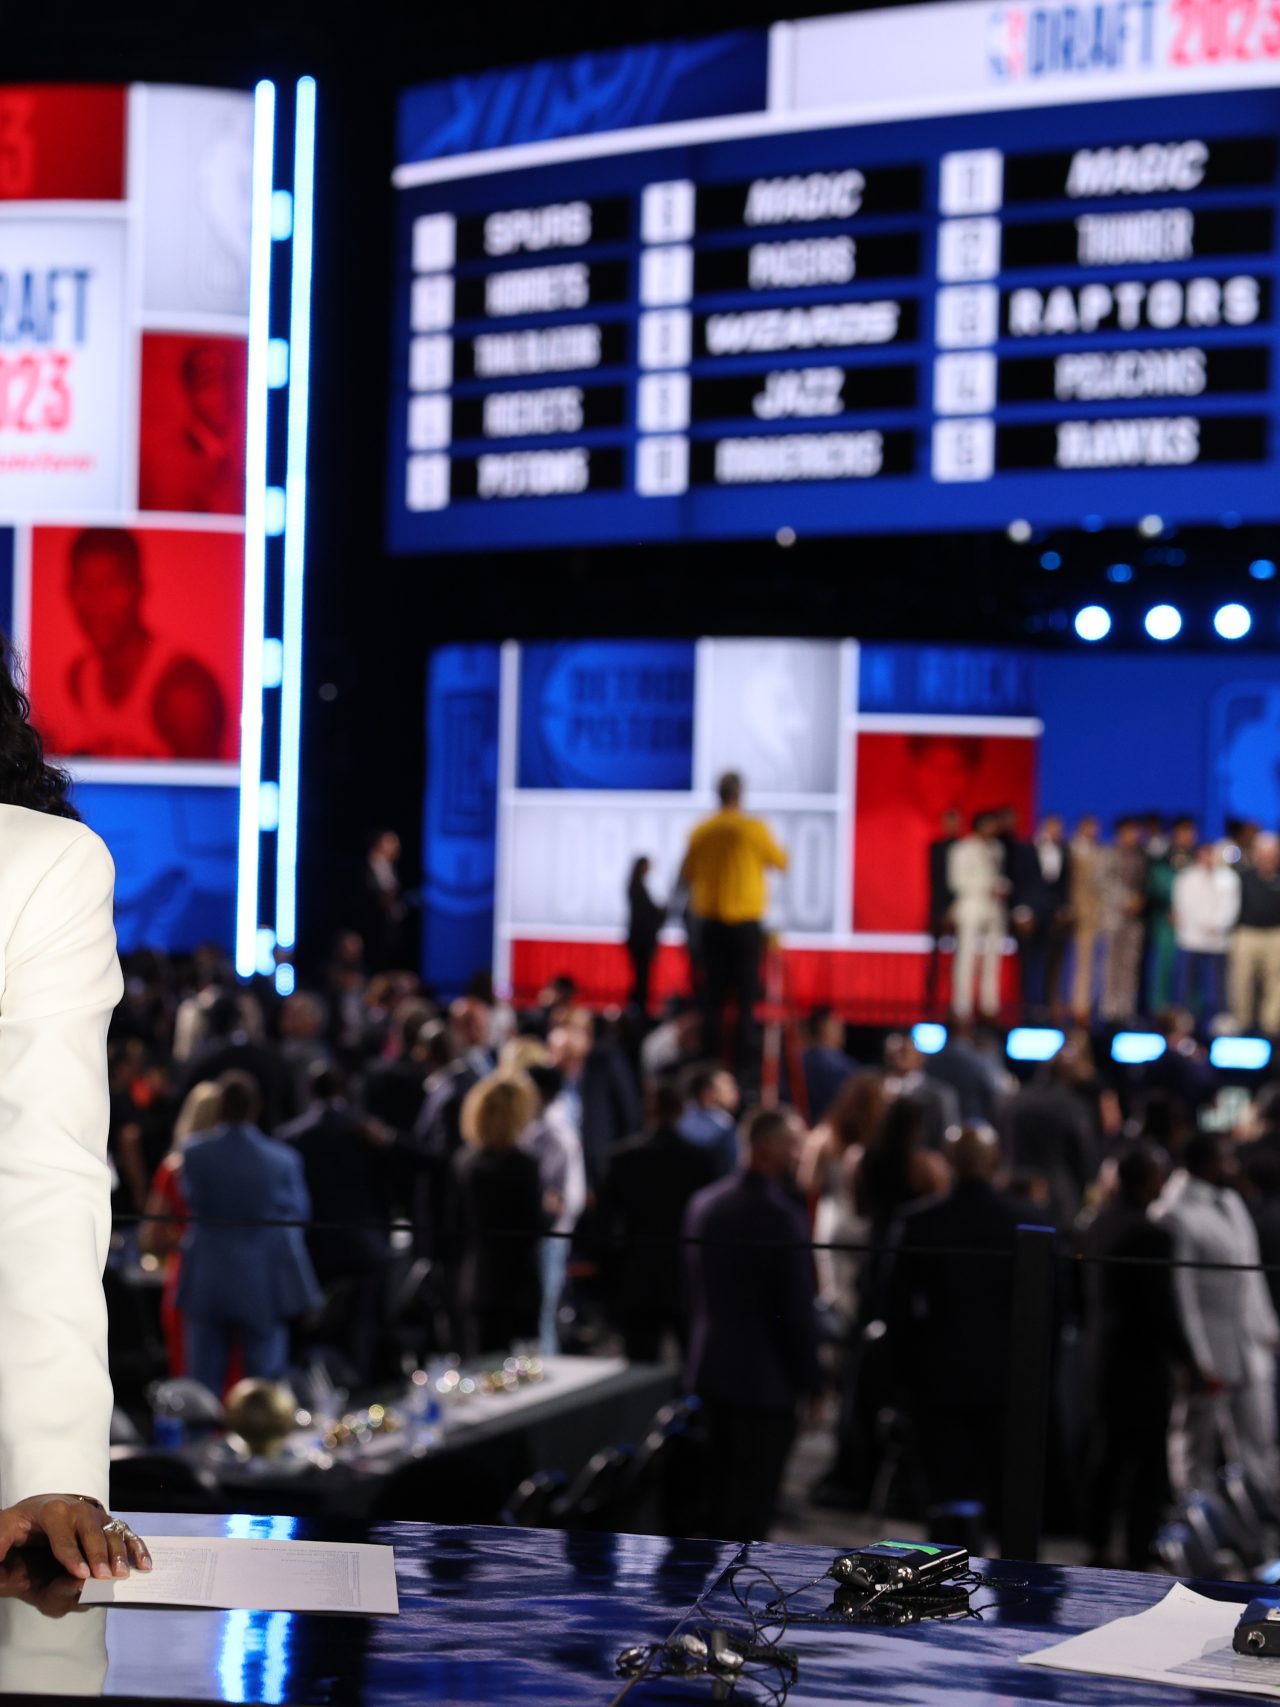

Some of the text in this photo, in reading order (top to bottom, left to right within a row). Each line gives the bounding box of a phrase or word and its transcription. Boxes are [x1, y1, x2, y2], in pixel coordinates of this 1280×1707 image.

[1029, 2, 1154, 76] DRAFT
[1067, 142, 1207, 196] MAGIC
[744, 170, 864, 225] MAGIC
[486, 203, 590, 255] SPURS
[1010, 277, 1258, 335] RAPTORS
[754, 368, 843, 418] JAZZ
